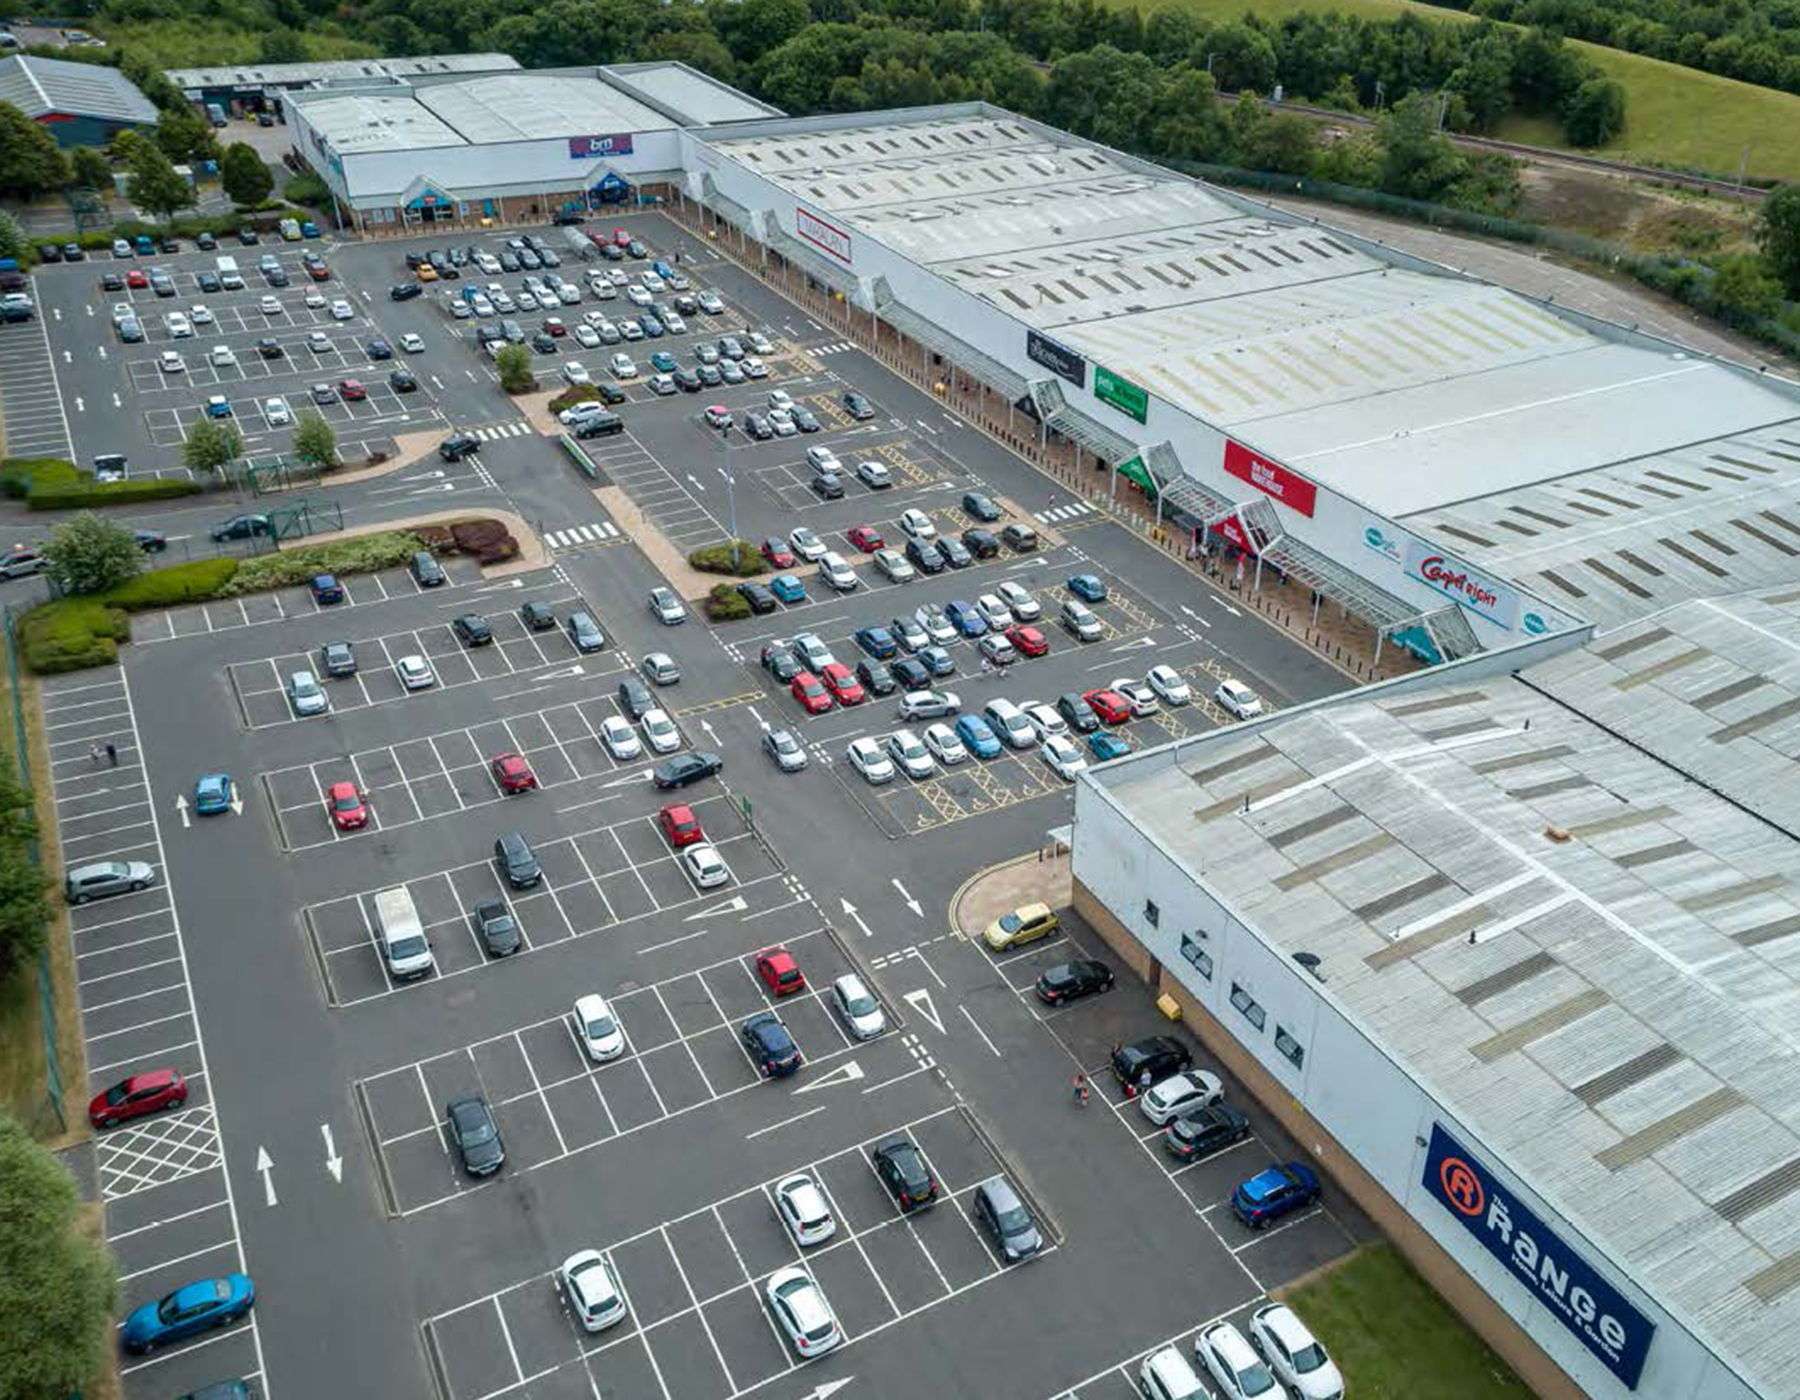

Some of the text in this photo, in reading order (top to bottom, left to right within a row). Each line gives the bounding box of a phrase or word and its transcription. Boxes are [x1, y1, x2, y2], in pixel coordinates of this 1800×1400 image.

[1421, 557, 1467, 590] Carpet
[1541, 1281, 1572, 1317] Leisure
[1584, 1324, 1620, 1363] Garden
